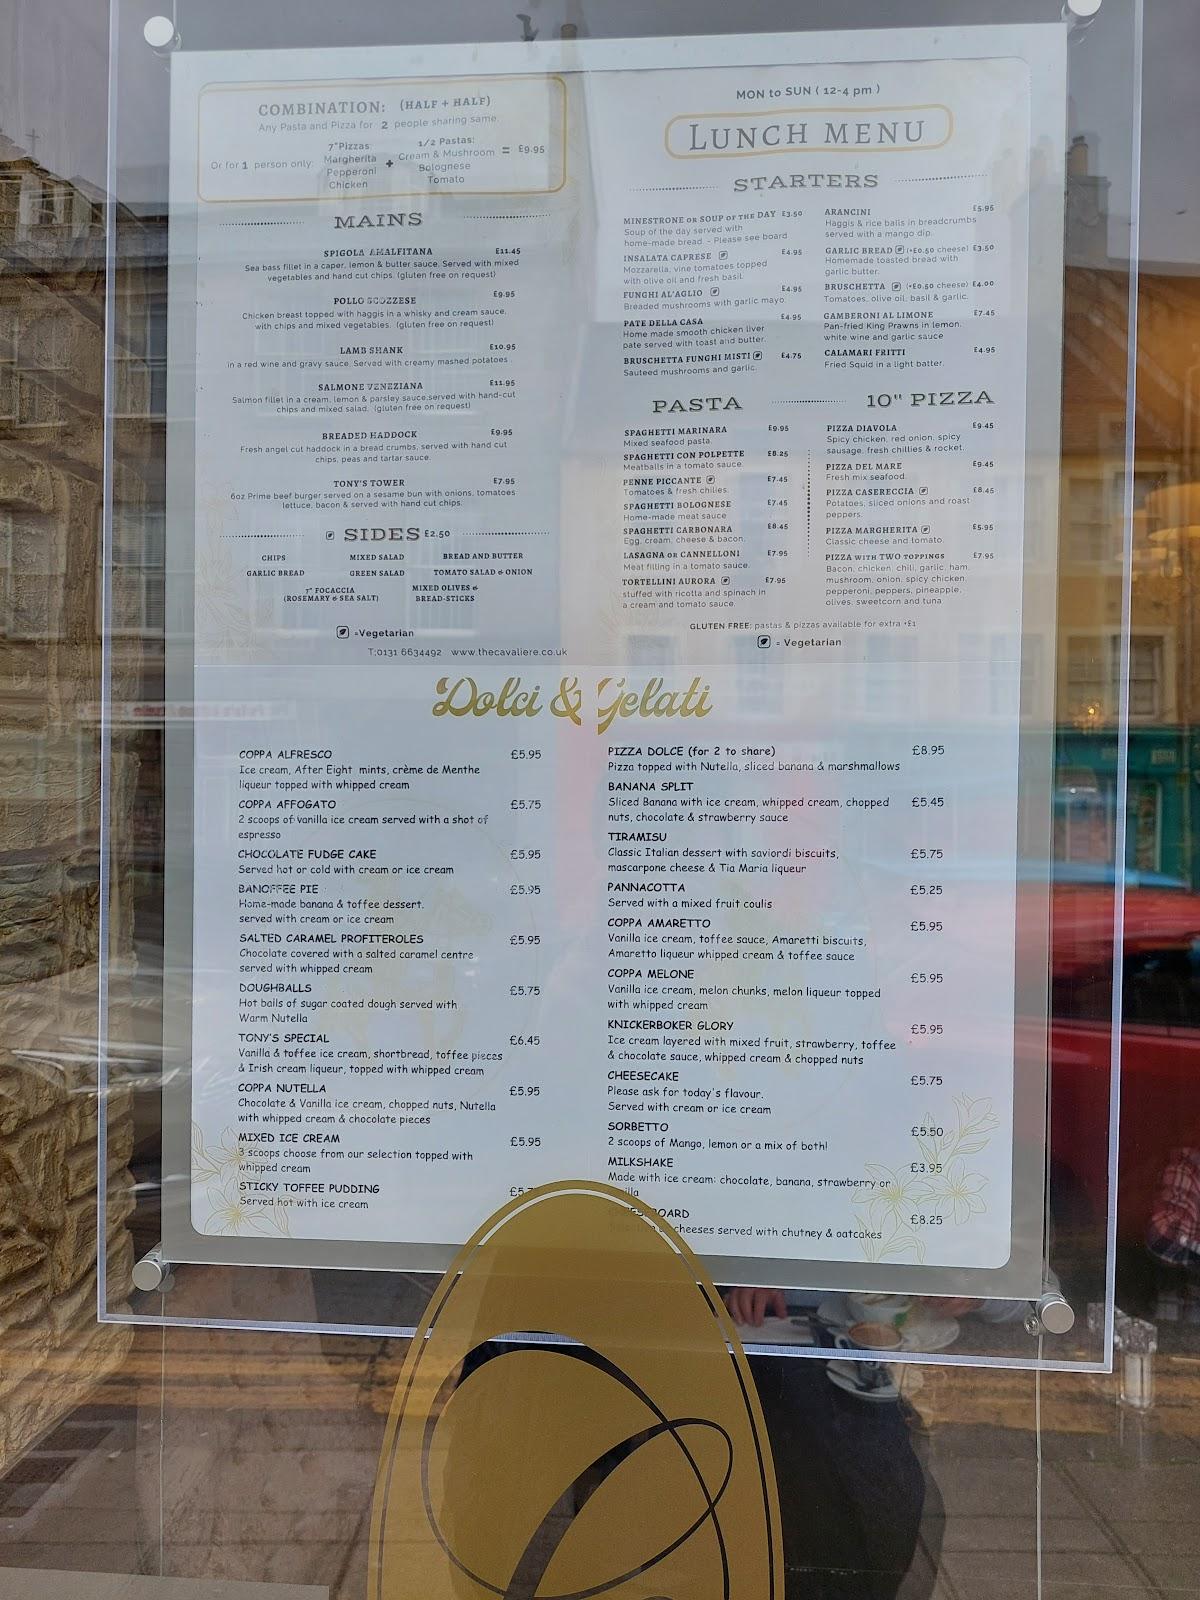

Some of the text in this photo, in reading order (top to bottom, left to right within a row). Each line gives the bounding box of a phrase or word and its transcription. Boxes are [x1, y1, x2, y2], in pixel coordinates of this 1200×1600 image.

[736, 89, 765, 100] MON
[768, 88, 782, 98] to
[785, 85, 811, 97] SUN
[853, 87, 872, 98] pm
[258, 100, 388, 117] COMBINATION:
[399, 98, 438, 112] (HALF
[453, 95, 491, 107] HALF)
[258, 122, 278, 134] Any
[280, 122, 307, 132] Pasta
[309, 121, 328, 131] and
[330, 120, 356, 130] Pizza
[359, 119, 374, 129] for
[394, 118, 429, 130] people
[431, 115, 468, 127] sharing
[823, 120, 925, 145] MENU
[323, 154, 377, 166] Margherita
[326, 166, 377, 179] Pepperoni
[417, 162, 471, 174] Bolognese
[427, 173, 465, 185] Tomato
[733, 173, 879, 193] STARTERS
[328, 180, 368, 191] Chicken
[824, 208, 871, 216] ARANCINI
[333, 212, 422, 230] MAINS
[333, 296, 365, 305] POLLO
[623, 317, 704, 328] PATE DELLA CASA
[340, 346, 404, 355] LAMB SHANK
[824, 348, 906, 357] CALAMARI FRITTI
[318, 382, 424, 392] SALMONE VENEZIANA
[910, 390, 995, 407] PIZZA
[652, 396, 743, 414] PASTA
[624, 425, 728, 437] SPAGHETTI MARINARA
[826, 424, 897, 432] PIZZA DIAVOLA
[322, 430, 418, 440] BREADED HADDOCK
[825, 462, 903, 471] PIZZA DEL MARE
[333, 479, 405, 488] TONY'S TOWER
[315, 501, 341, 509] bacon
[350, 500, 379, 508] served
[380, 500, 399, 508] with
[400, 499, 421, 507] hand
[422, 499, 437, 507] cut
[343, 527, 420, 542] SIDES
[261, 553, 287, 562] CHIPS
[349, 553, 405, 561] MIXED SALAD
[442, 552, 524, 560] BREAD AND BUTTER
[246, 569, 305, 577] GARLIC BREAD
[349, 569, 405, 577] GREEN SALAD
[415, 594, 475, 602] BREAD-STICKS
[783, 637, 842, 649] Vegetarian
[400, 647, 442, 658] 6634492
[450, 647, 568, 657] www.thecavaliere.co.uk
[432, 677, 714, 736] Dolci & Gelati
[239, 749, 333, 760] COPPA ALFRESCO
[607, 746, 643, 757] PIZZA
[647, 746, 684, 757] DOLCE
[687, 745, 710, 758] (for
[725, 747, 737, 756] to
[741, 745, 776, 758] share)
[911, 744, 945, 756] £8.95
[608, 781, 695, 792] BANANA SPLIT
[911, 796, 944, 808] £5.45
[607, 832, 667, 842] TIRAMISU
[237, 849, 377, 860] CHOCOLATE FUDGE CAKE
[909, 848, 944, 860] £5.75
[238, 864, 274, 874] Served
[276, 864, 293, 874] hot
[310, 864, 331, 874] cold
[333, 864, 355, 875] with
[358, 867, 389, 875] cream
[406, 864, 421, 874] ice
[423, 867, 455, 875] cream
[607, 882, 686, 893] PANNACOTTA
[909, 884, 943, 896] £5.25
[239, 933, 424, 944] SALTED CARAMEL PROFITEROLES
[509, 934, 541, 946] £5.95
[239, 982, 312, 993] DOUGHBALLS
[237, 1033, 330, 1044] TONY'S SPECIAL
[607, 1070, 680, 1082] CHEESECAKE
[607, 1121, 669, 1132] SORBETTO
[238, 1132, 341, 1144] MIXED ICE CREAM
[607, 1156, 674, 1168] MILKSHAKE
[910, 1162, 943, 1174] £3.95
[239, 1181, 380, 1194] STICKY TOFFEE PUDDING
[909, 1213, 943, 1226] £8.25
[674, 1224, 715, 1234] cheeses
[717, 1225, 753, 1236] served
[755, 1226, 779, 1237] with
[781, 1227, 823, 1240] chutney
[825, 1227, 833, 1238] &
[836, 1229, 882, 1240] oatcakes
